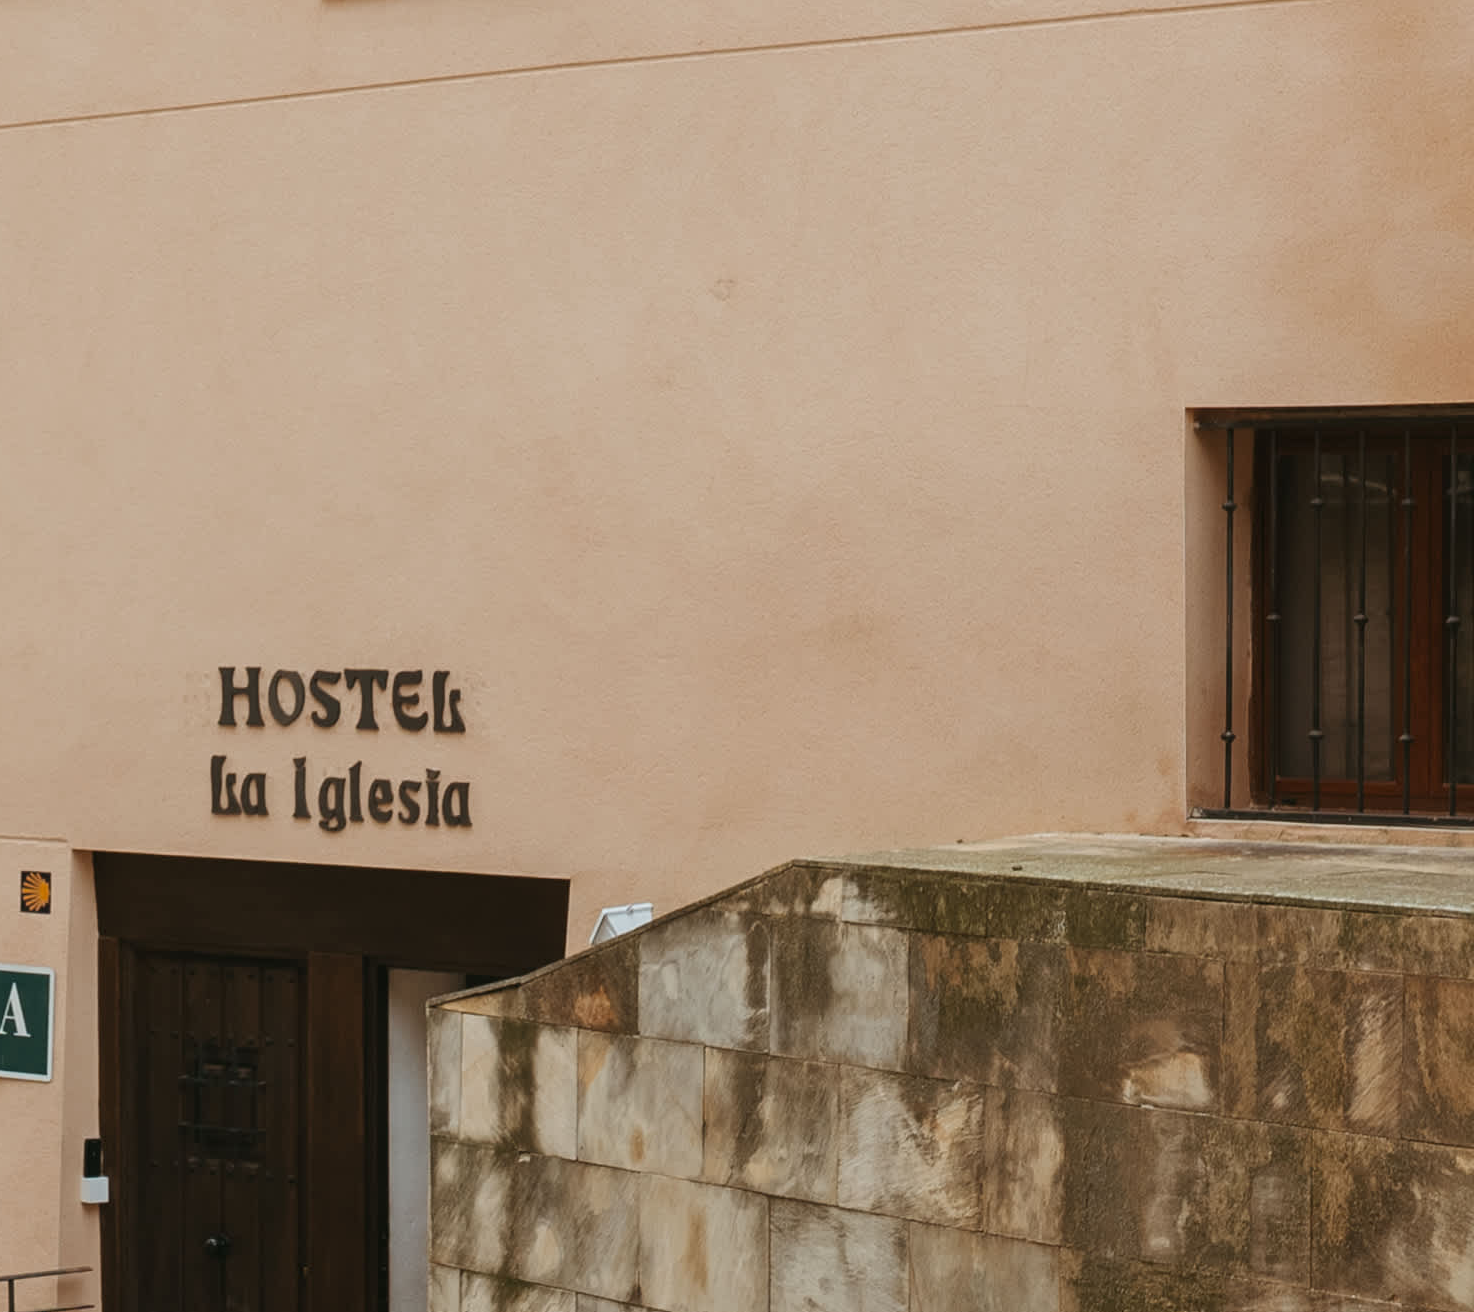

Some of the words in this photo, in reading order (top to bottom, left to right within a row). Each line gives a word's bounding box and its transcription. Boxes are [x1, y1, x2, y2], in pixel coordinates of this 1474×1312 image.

[218, 666, 466, 733] HOSTEL
[210, 755, 269, 816] La
[293, 756, 472, 833] Iglesia
